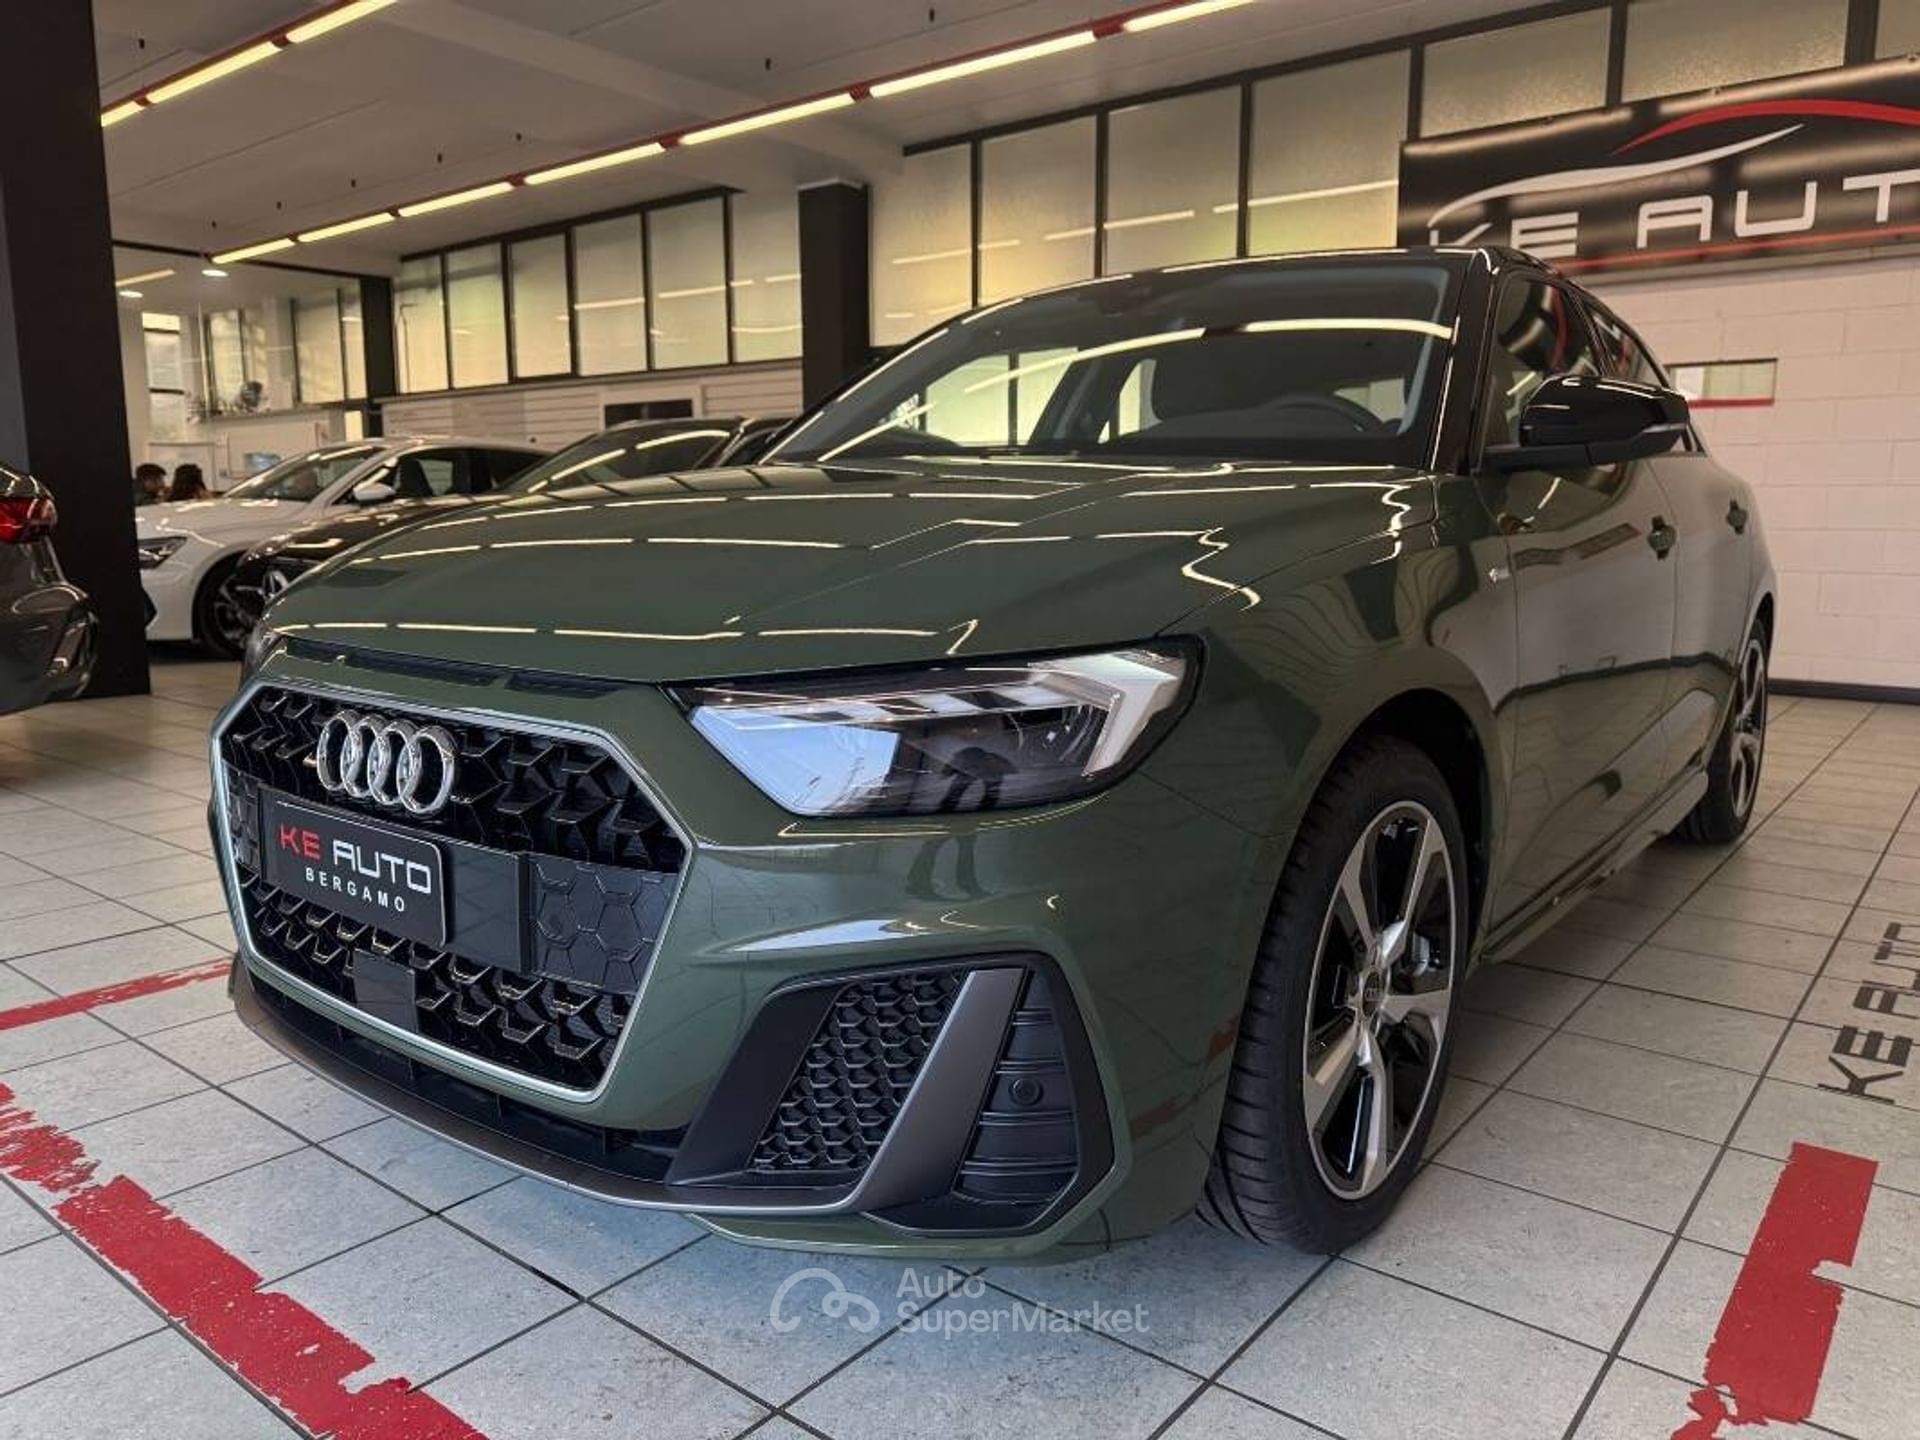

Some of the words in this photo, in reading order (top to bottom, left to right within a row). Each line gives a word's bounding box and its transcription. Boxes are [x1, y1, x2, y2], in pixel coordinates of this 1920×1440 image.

[1637, 169, 1920, 249] AUT
[279, 823, 322, 861] KE
[332, 839, 432, 894] AUTO
[304, 867, 406, 912] BERGAMO
[1817, 1025, 1914, 1104] KE
